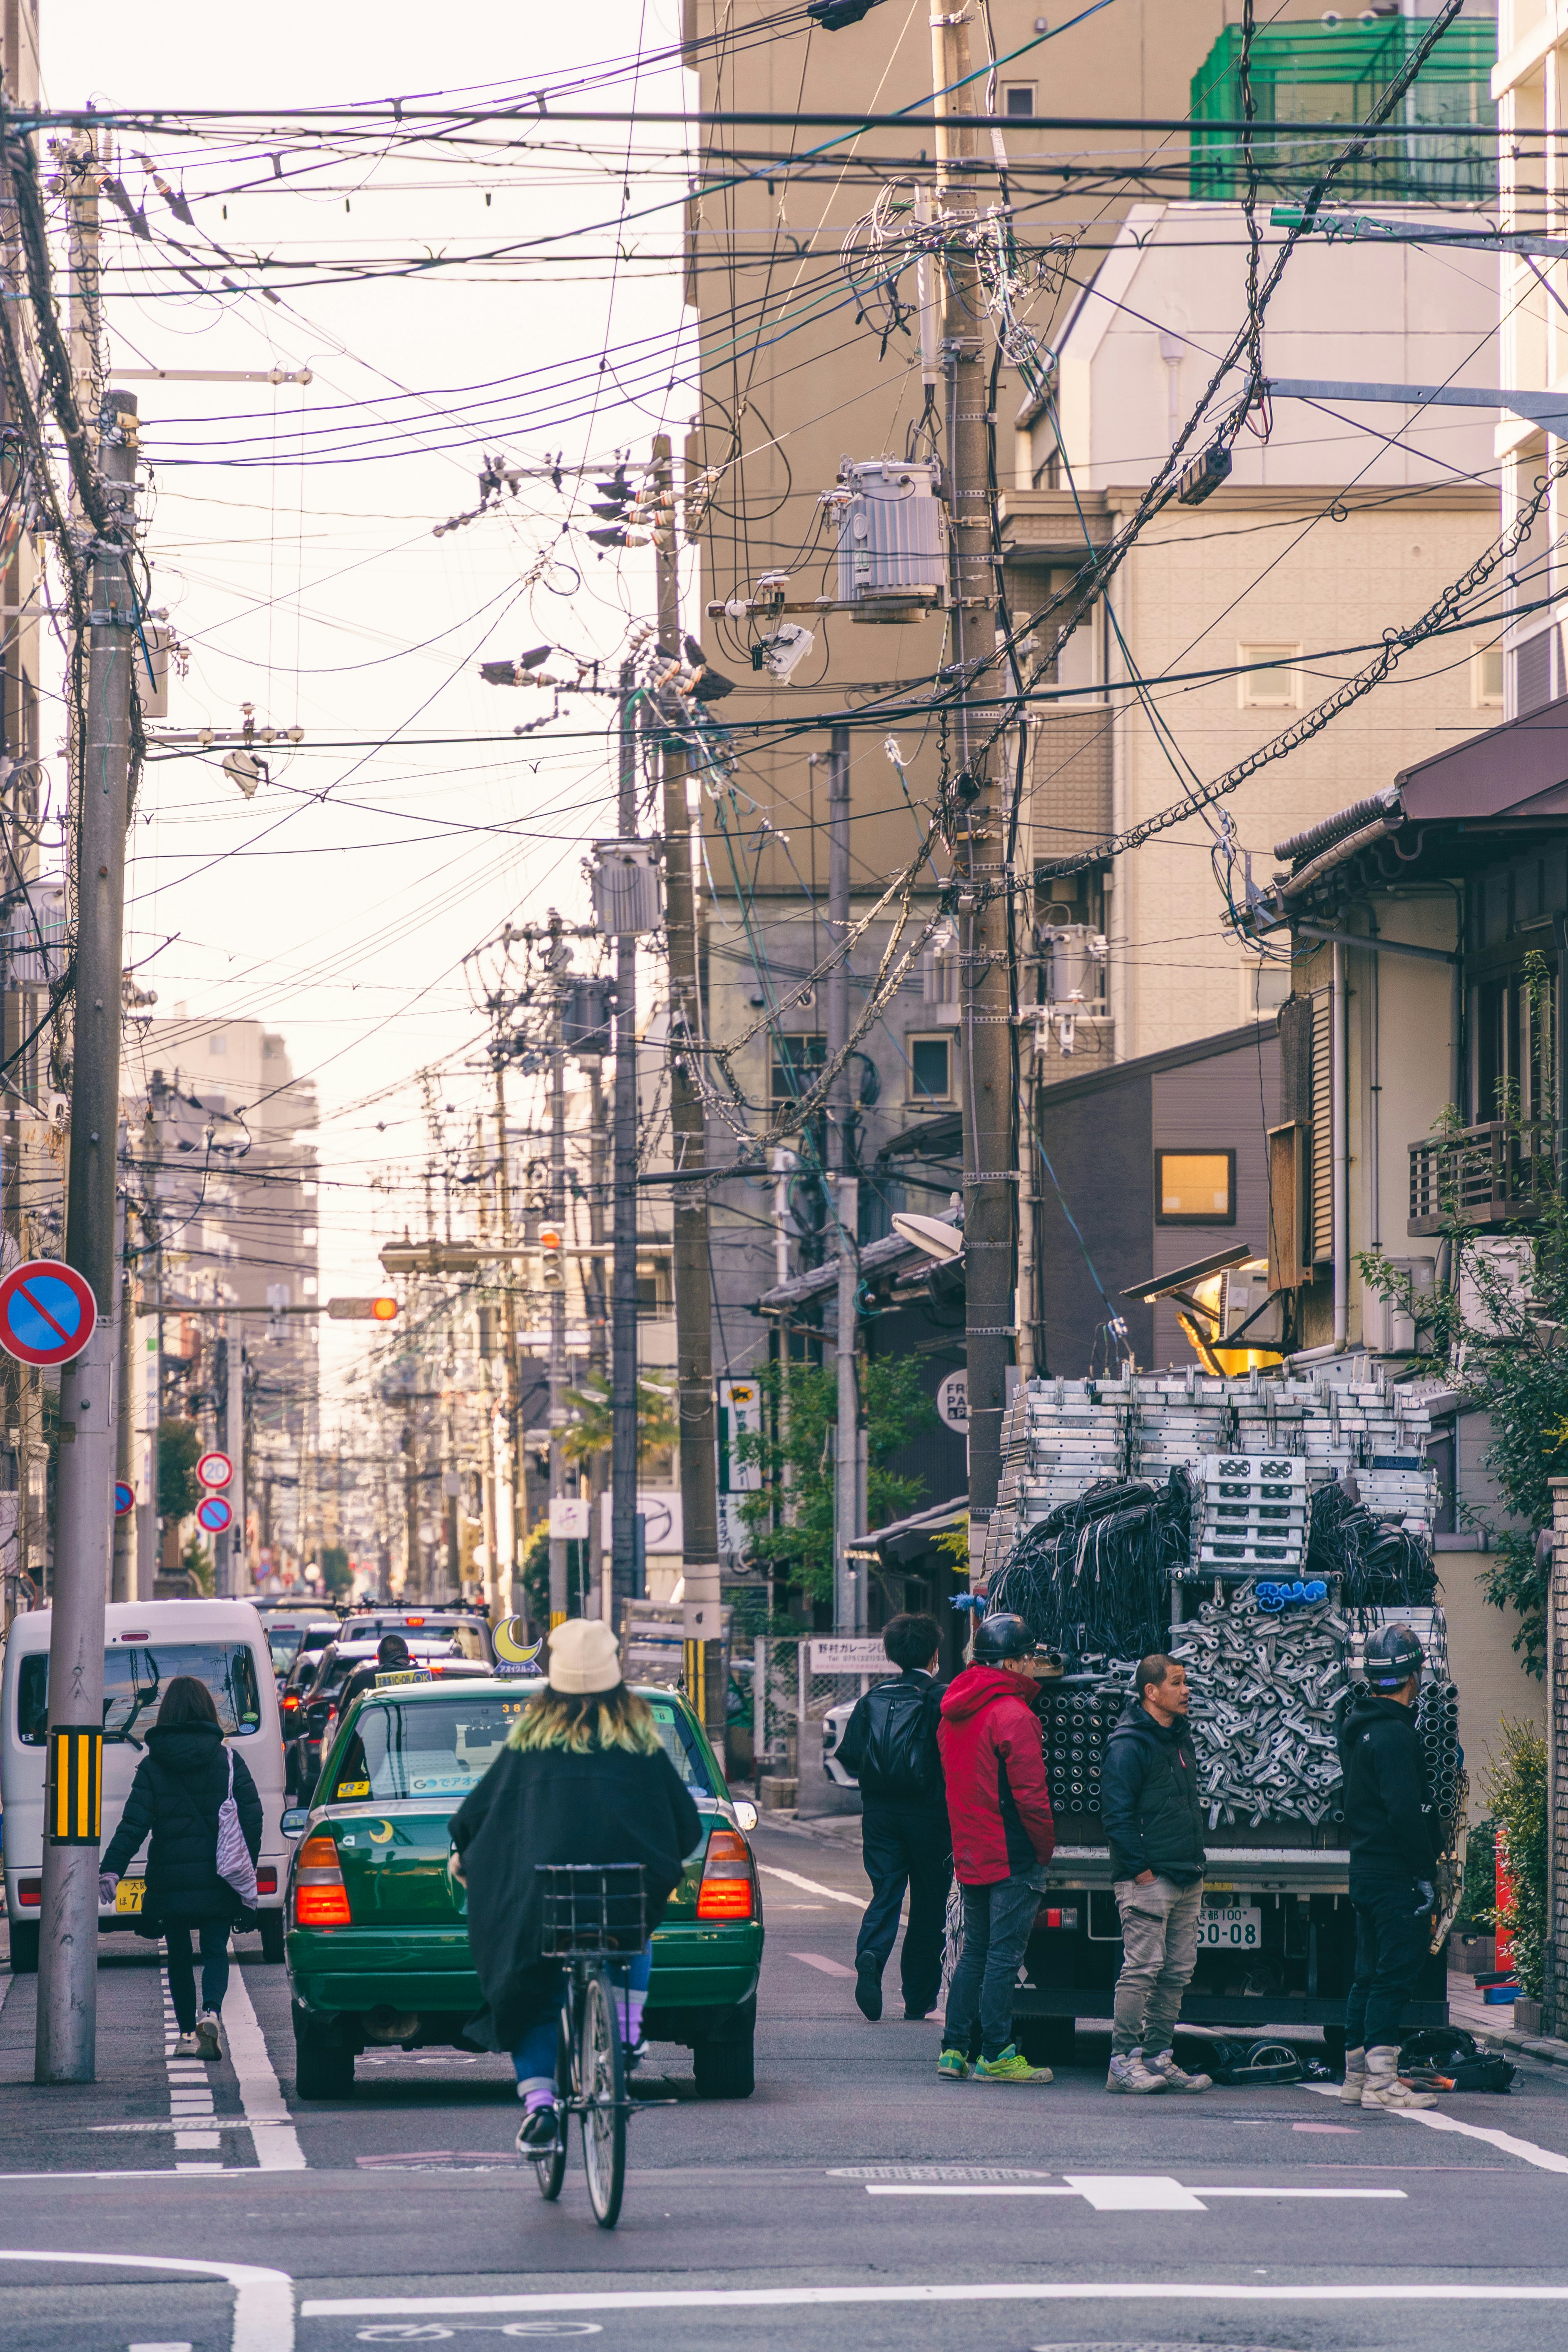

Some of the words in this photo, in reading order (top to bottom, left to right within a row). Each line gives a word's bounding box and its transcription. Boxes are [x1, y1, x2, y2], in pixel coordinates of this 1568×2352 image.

[947, 1384, 967, 1394] FR
[949, 1408, 967, 1419] &P
[206, 1462, 225, 1479] 20
[1421, 1804, 1432, 1812] LE
[119, 1897, 127, 1905] ほ
[1222, 1909, 1241, 1920] 100
